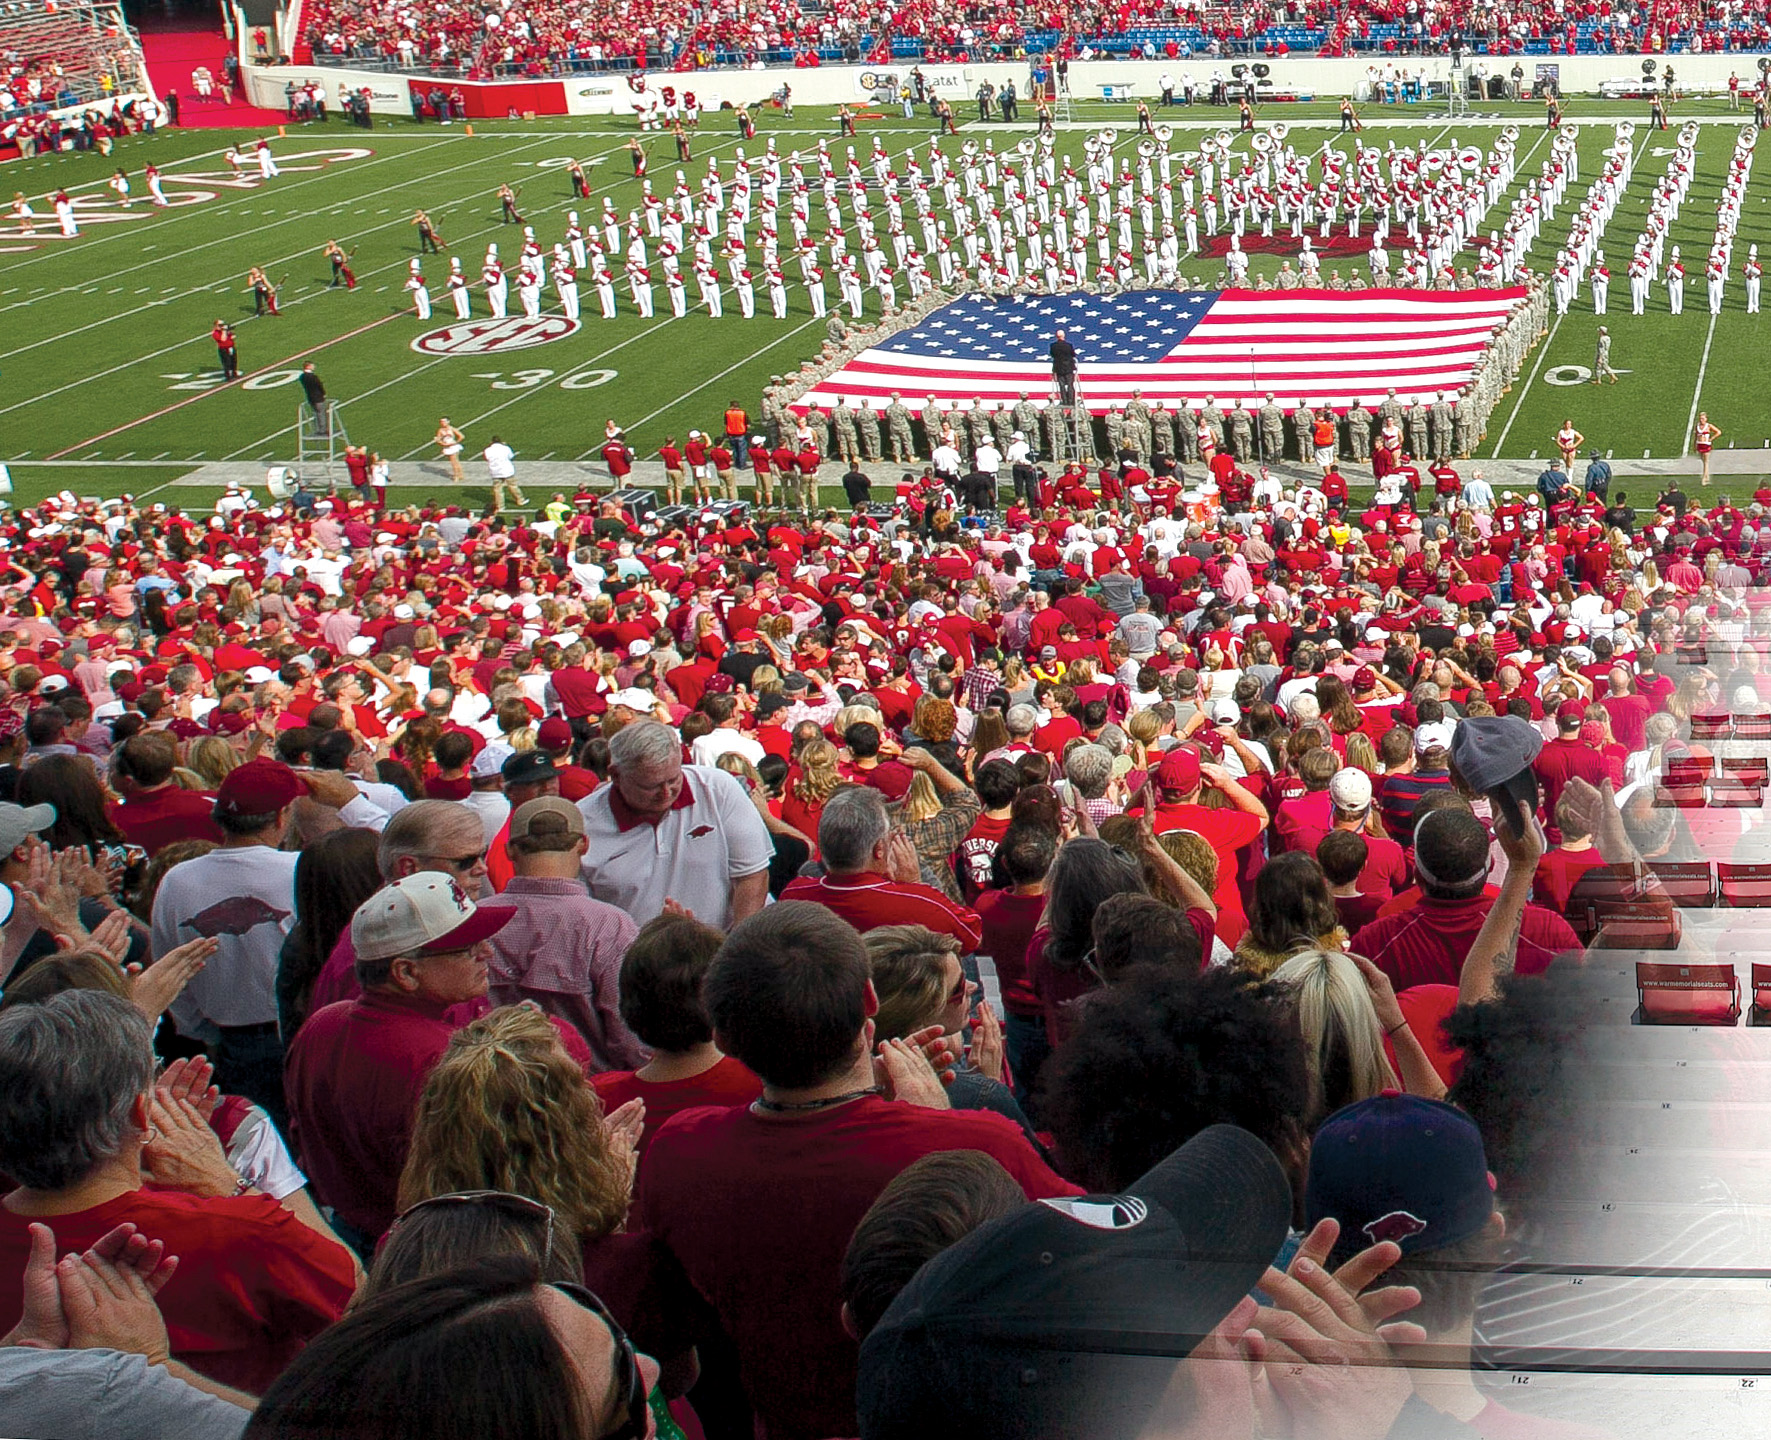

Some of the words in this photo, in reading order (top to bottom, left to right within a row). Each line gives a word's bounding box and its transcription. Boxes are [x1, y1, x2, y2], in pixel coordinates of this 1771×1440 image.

[932, 75, 959, 87] at&t
[424, 319, 567, 354] SEC
[489, 368, 619, 390] 30
[1502, 515, 1515, 532] 5
[1642, 979, 1729, 989] www.warmemorialseats.com
[1741, 1378, 1755, 1388] 22
